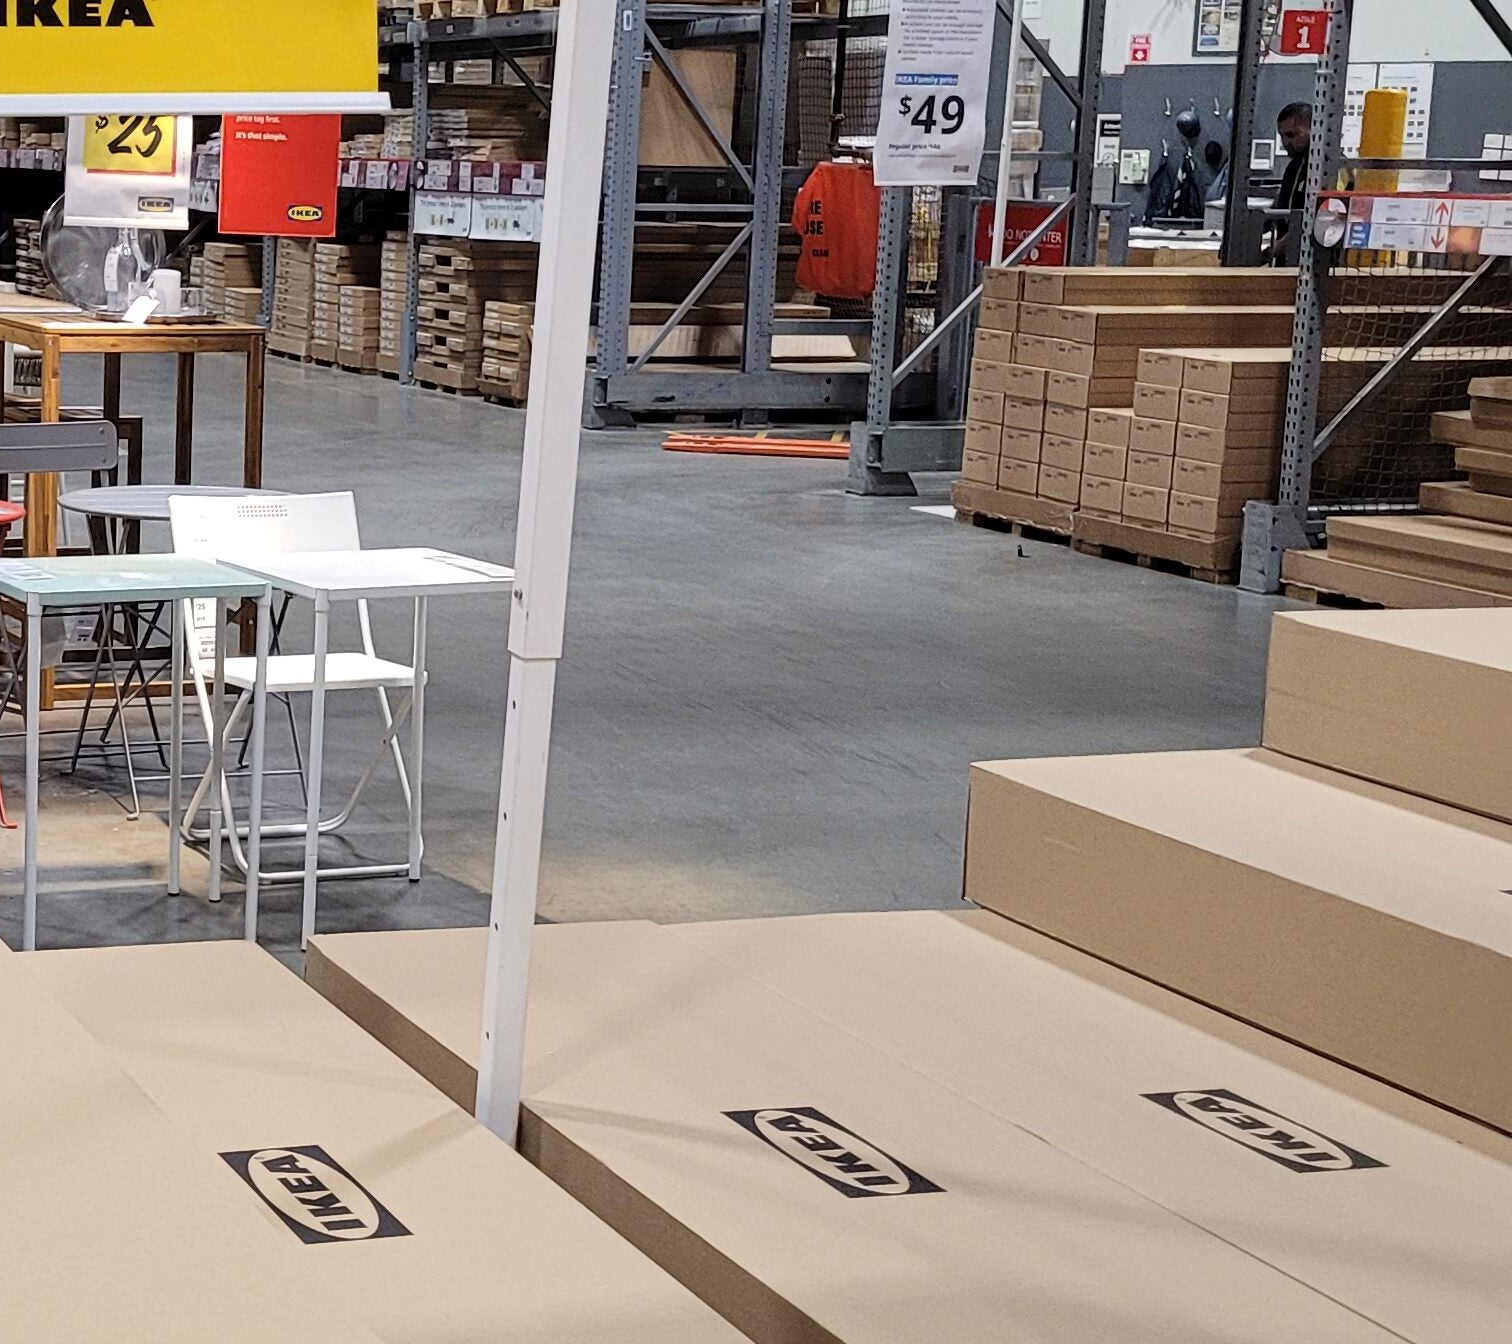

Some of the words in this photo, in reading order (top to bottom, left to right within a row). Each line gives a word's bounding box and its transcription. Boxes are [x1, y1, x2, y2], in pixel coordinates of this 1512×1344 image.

[1296, 26, 1310, 49] 1
[899, 94, 965, 134] $49
[141, 199, 171, 209] IKEA
[291, 208, 320, 217] IKEA
[1187, 1097, 1341, 1162] IKEA
[766, 1115, 900, 1187] IKEA
[260, 1154, 368, 1231] IKEA
